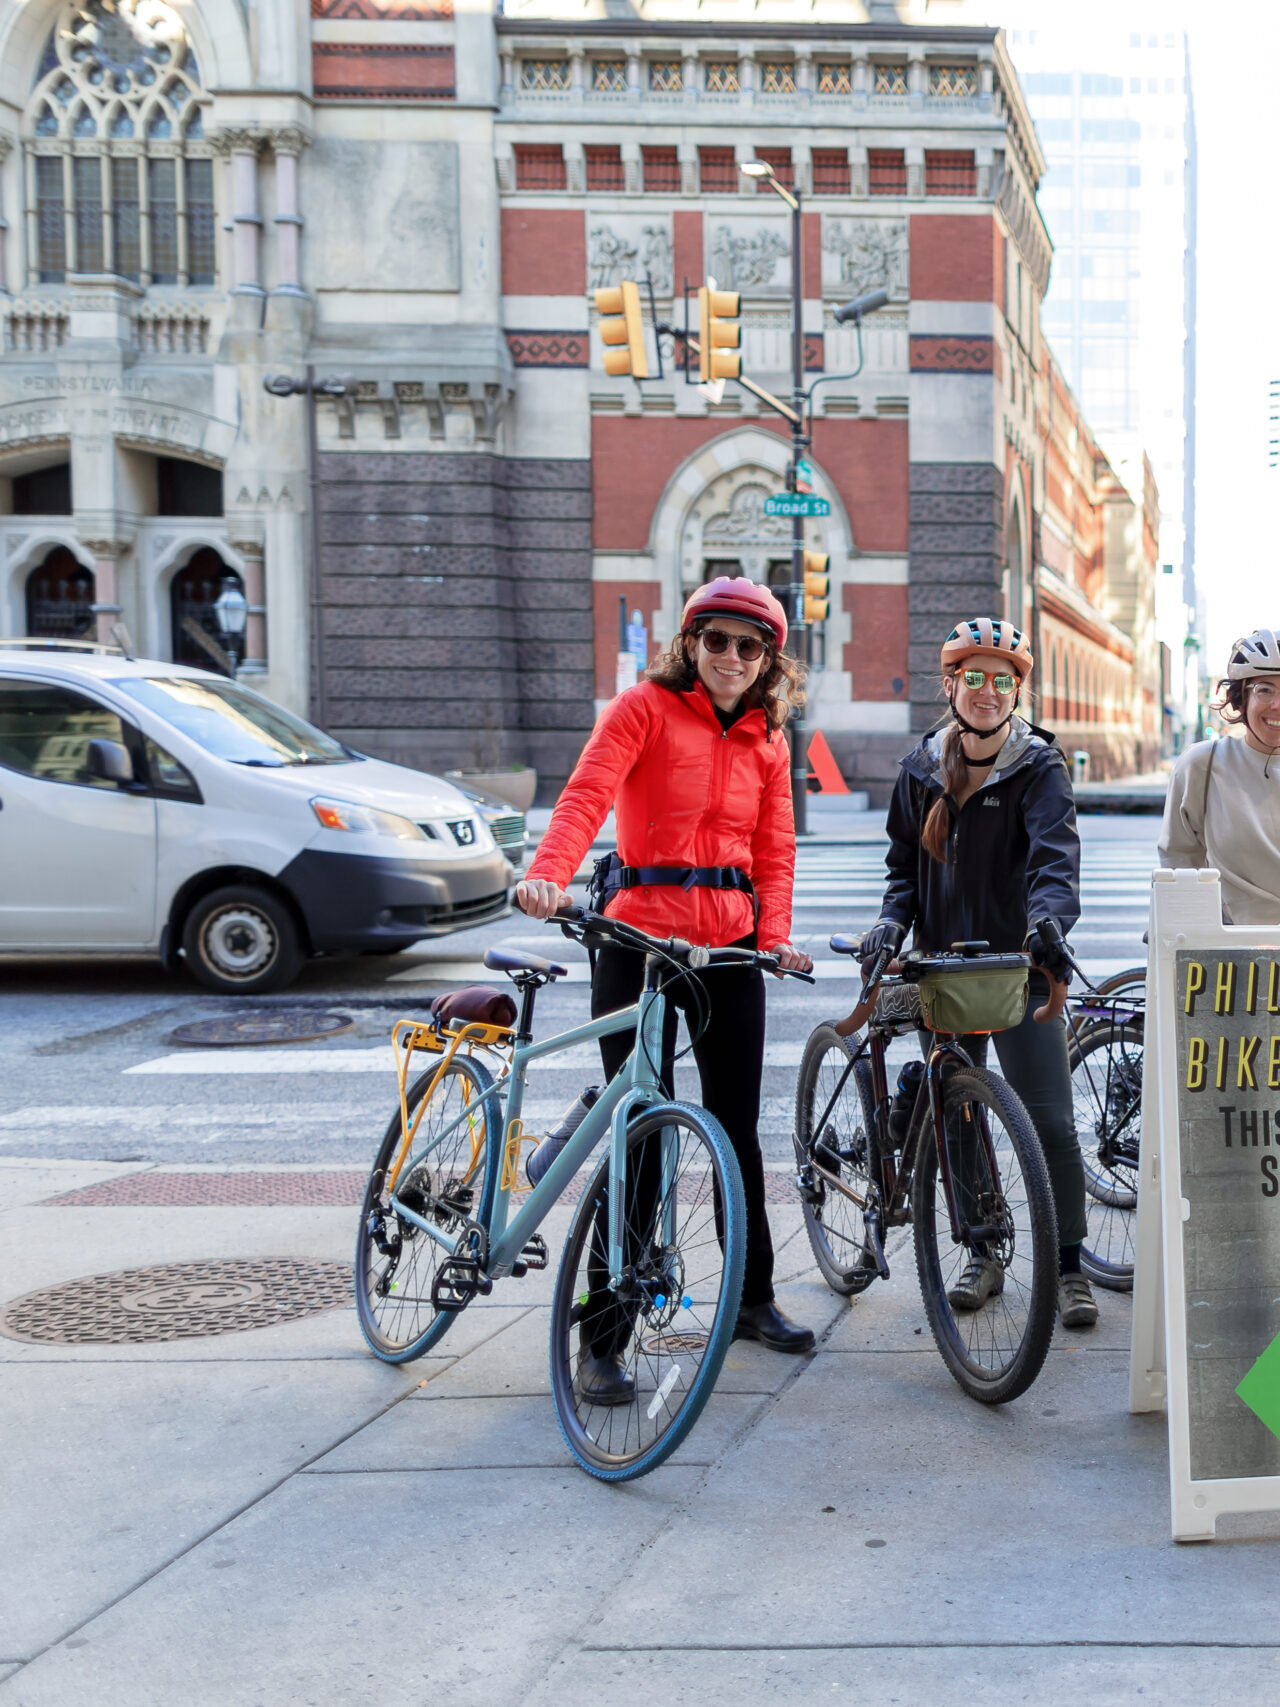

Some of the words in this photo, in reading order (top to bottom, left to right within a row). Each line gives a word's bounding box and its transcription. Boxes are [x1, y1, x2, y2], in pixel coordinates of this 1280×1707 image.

[23, 376, 153, 392] PENNSYLVANIA
[767, 500, 809, 514] Broad
[814, 501, 828, 514] St
